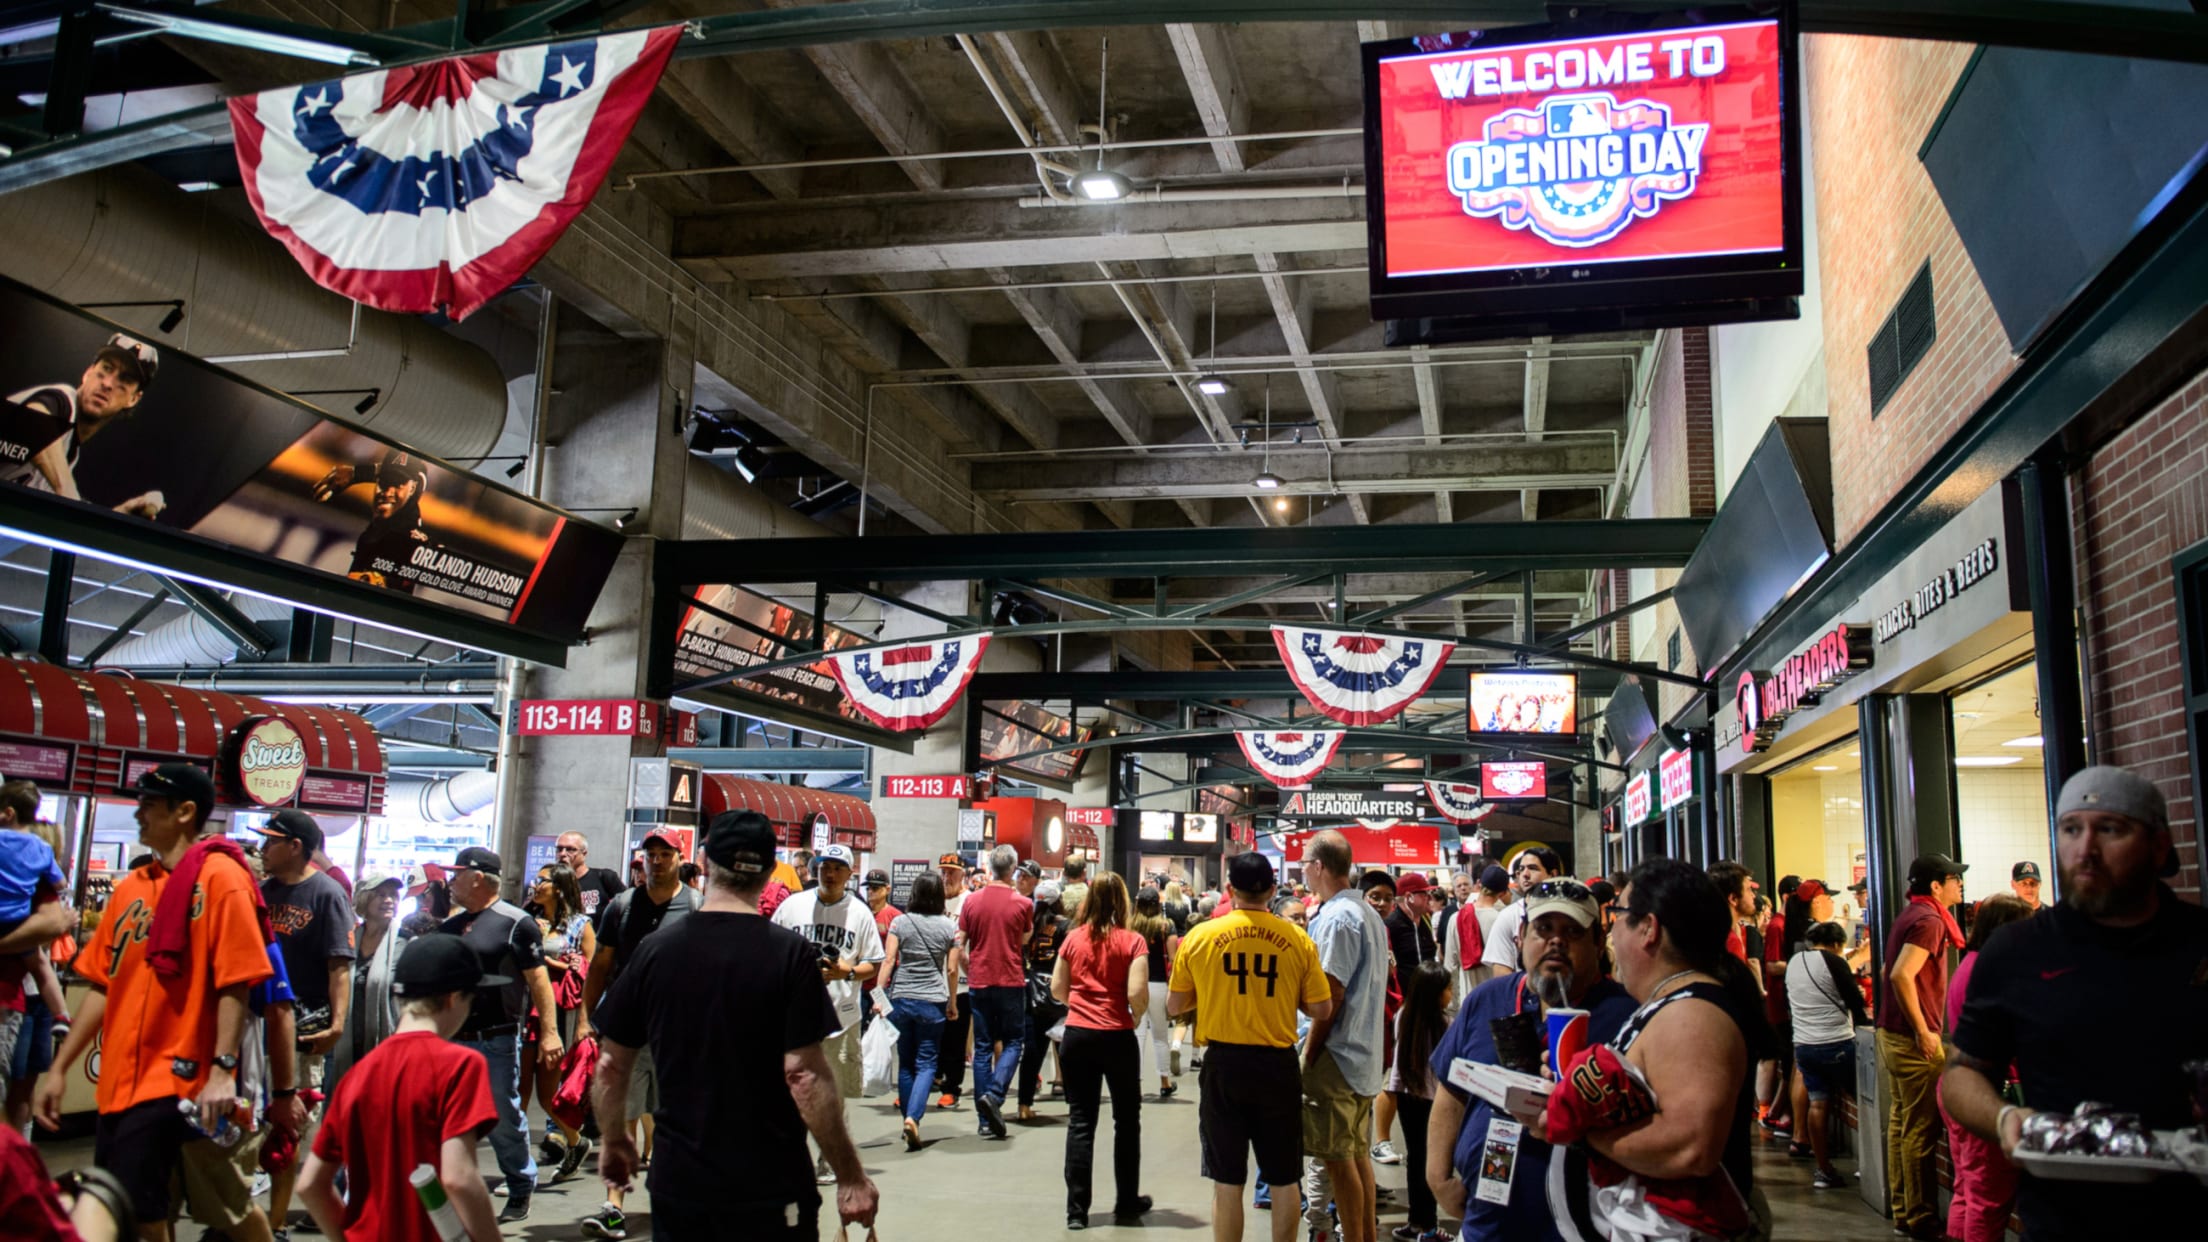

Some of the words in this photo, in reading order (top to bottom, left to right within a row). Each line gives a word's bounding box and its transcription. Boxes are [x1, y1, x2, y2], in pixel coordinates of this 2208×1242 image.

[1430, 43, 1654, 99] WELCOME
[1660, 36, 1726, 78] TO
[1451, 136, 1625, 190] OPENING
[1629, 126, 1707, 175] DAY
[0, 440, 29, 461] NER
[410, 546, 473, 580] ORLANDO
[470, 565, 524, 596] HUDSON
[1915, 576, 1944, 619] BITES
[1945, 569, 1956, 598] &
[1957, 539, 1996, 590] BEERS
[398, 565, 420, 579] 2007
[418, 572, 441, 586] GOLD
[439, 580, 463, 593] GLOVE
[462, 585, 488, 601] AWARD
[486, 592, 514, 608] WINNER
[680, 633, 717, 656] D-BACKS
[713, 644, 751, 666] HONORED
[526, 705, 603, 731] 113-114
[617, 705, 633, 731] B
[640, 703, 647, 718] B
[689, 715, 696, 729] A
[640, 718, 652, 734] 113
[683, 728, 695, 743] 113
[242, 736, 304, 770] Sweet
[253, 778, 292, 790] TREATS
[891, 779, 944, 795] 112-113
[952, 779, 964, 795] A
[1306, 792, 1337, 801] SEASON
[1338, 793, 1363, 801] TICKET
[1306, 800, 1414, 816] HEADQUARTERS
[1223, 952, 1279, 997] 44
